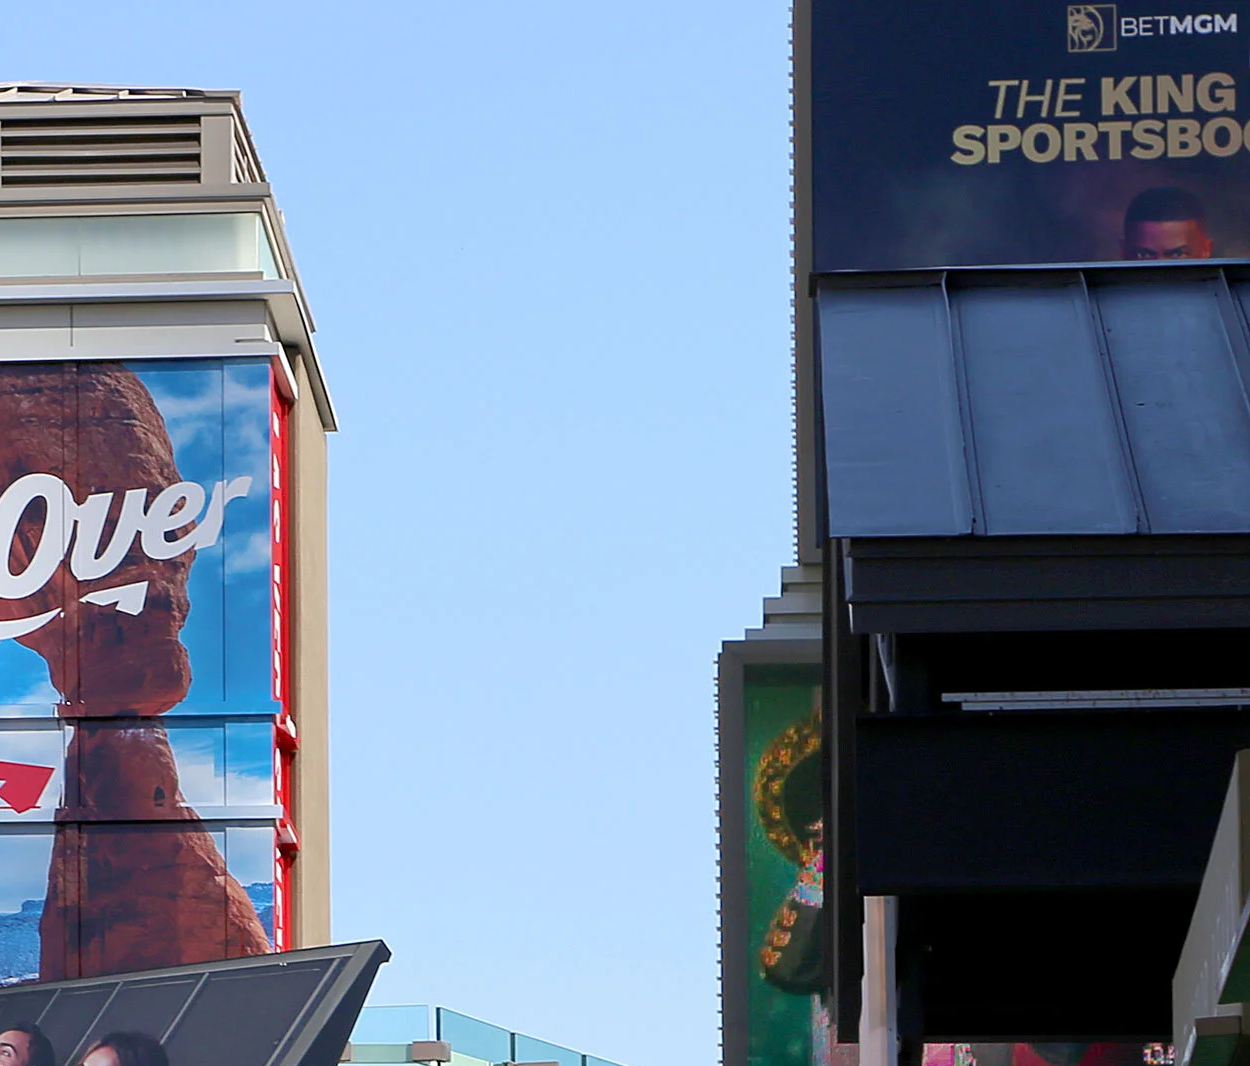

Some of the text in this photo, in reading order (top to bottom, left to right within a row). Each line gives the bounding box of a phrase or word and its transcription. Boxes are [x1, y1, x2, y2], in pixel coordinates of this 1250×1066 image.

[1120, 13, 1238, 37] BETMGM
[988, 72, 1237, 119] THE KING
[950, 117, 1250, 165] SPORTSBO
